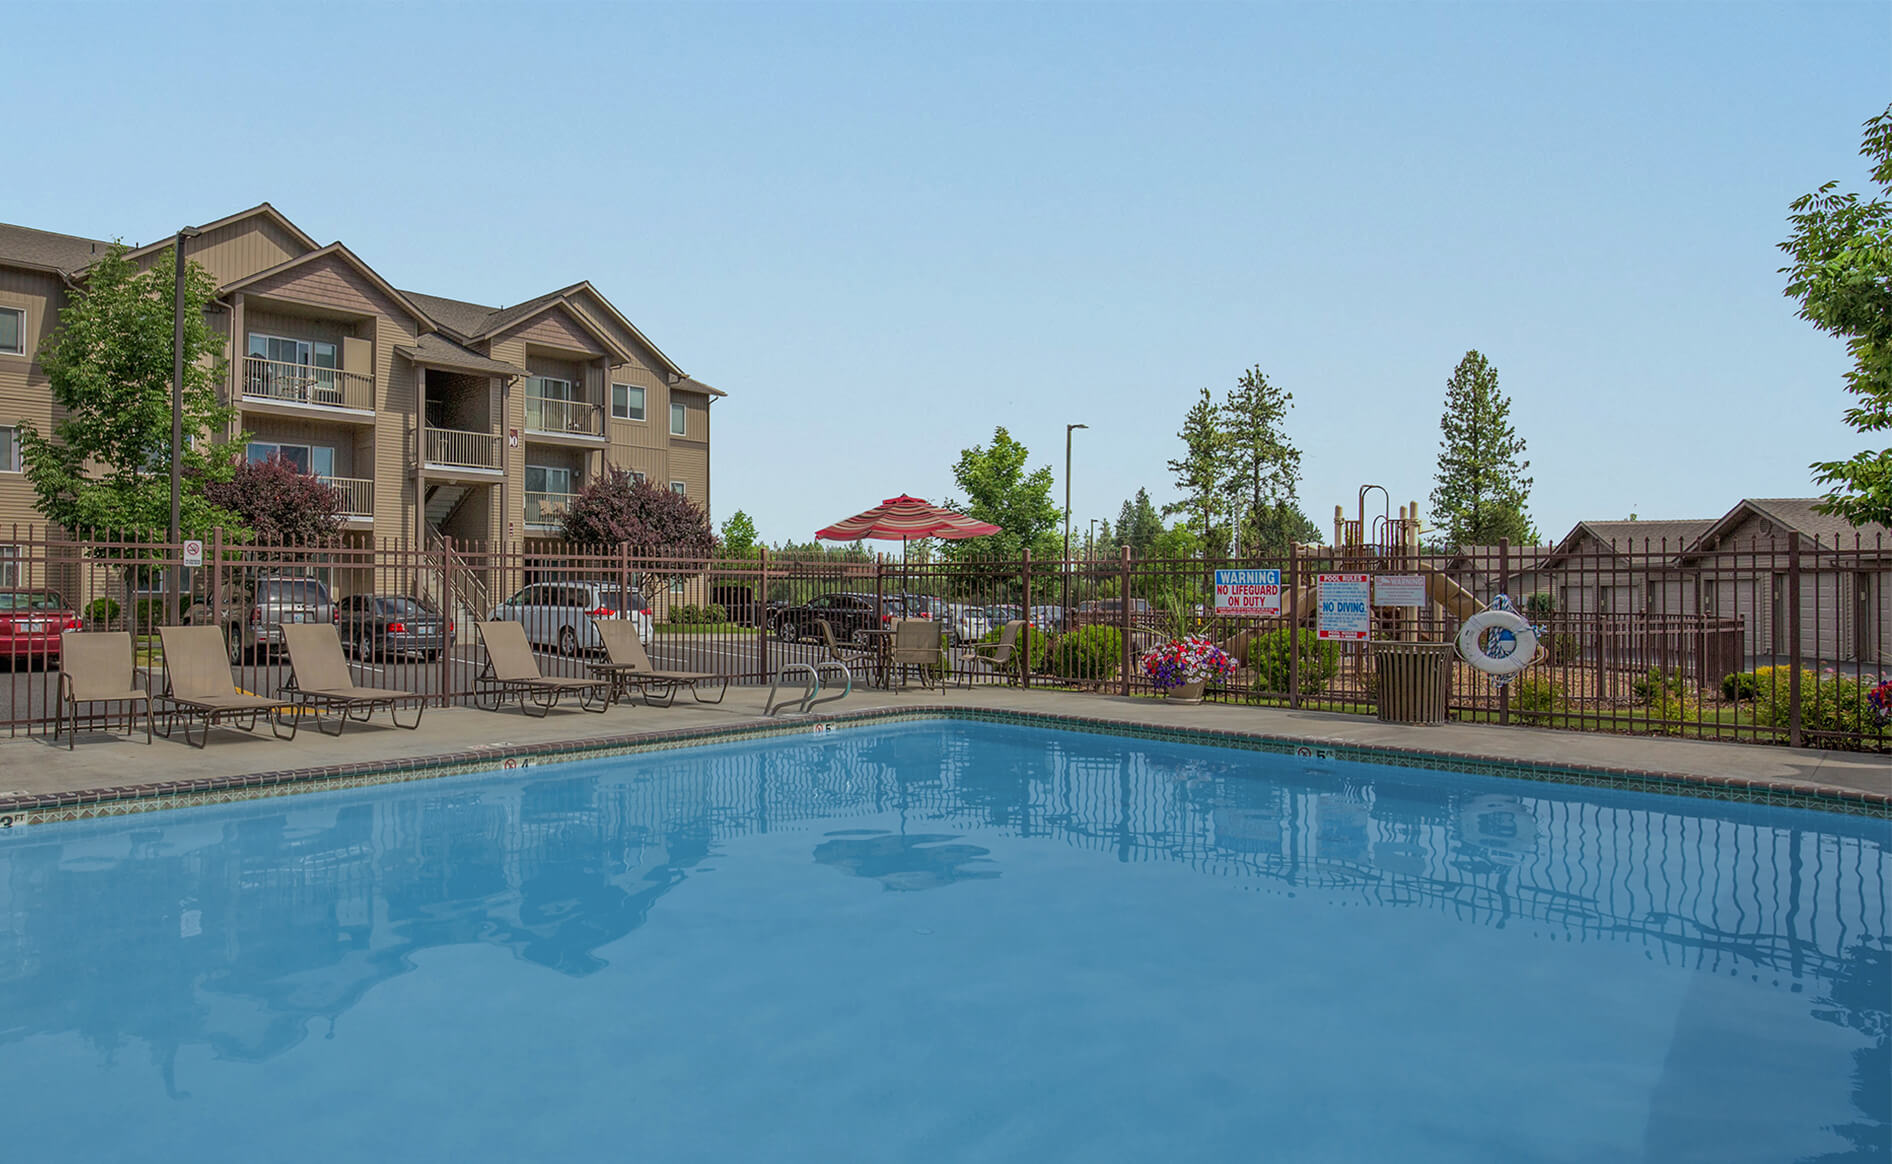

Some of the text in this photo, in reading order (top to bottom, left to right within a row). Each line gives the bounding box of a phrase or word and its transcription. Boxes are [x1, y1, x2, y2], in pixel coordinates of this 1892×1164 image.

[1220, 571, 1275, 584] WARNING
[1216, 585, 1278, 595] NO LIFEGUARD
[1228, 596, 1265, 607] ON DUTY
[1323, 602, 1365, 613] NO DIVING
